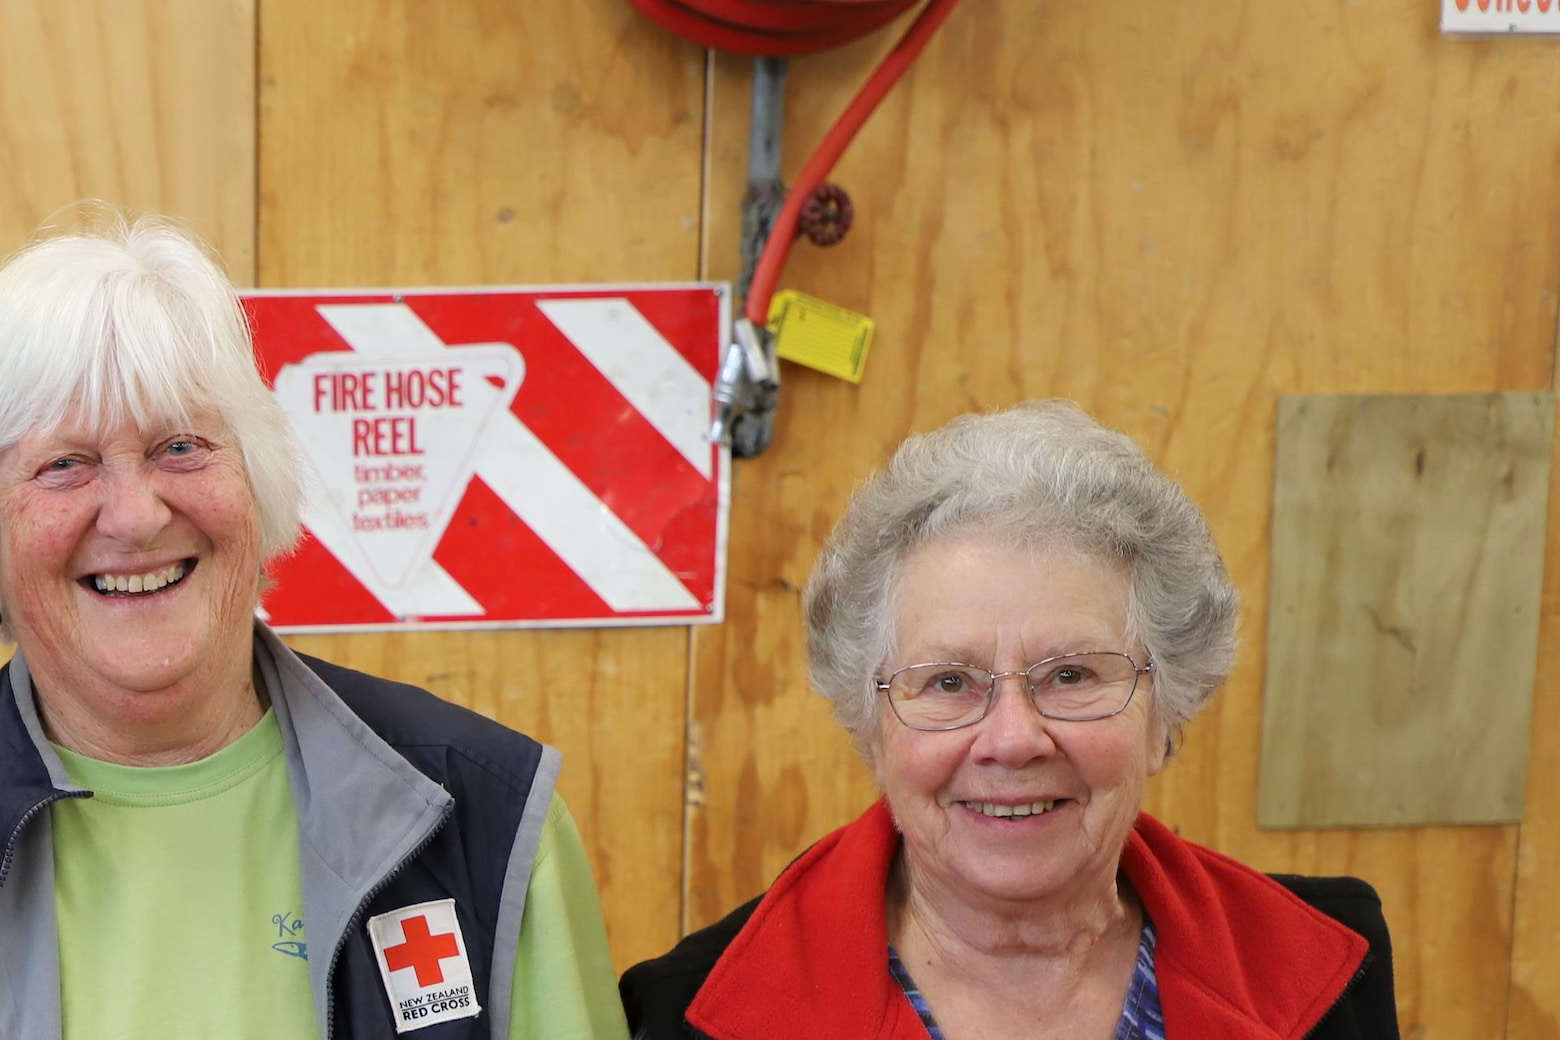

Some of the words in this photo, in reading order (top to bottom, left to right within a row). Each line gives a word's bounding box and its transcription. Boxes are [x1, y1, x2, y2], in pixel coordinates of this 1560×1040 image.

[313, 372, 377, 412] FIRE
[385, 368, 463, 409] HOSE
[353, 417, 425, 456] REEL
[272, 912, 304, 936] Ka
[399, 997, 423, 1009] NEW
[426, 986, 469, 1002] ZEALAND
[403, 1008, 429, 1021] RED
[432, 997, 470, 1014] CROSS
